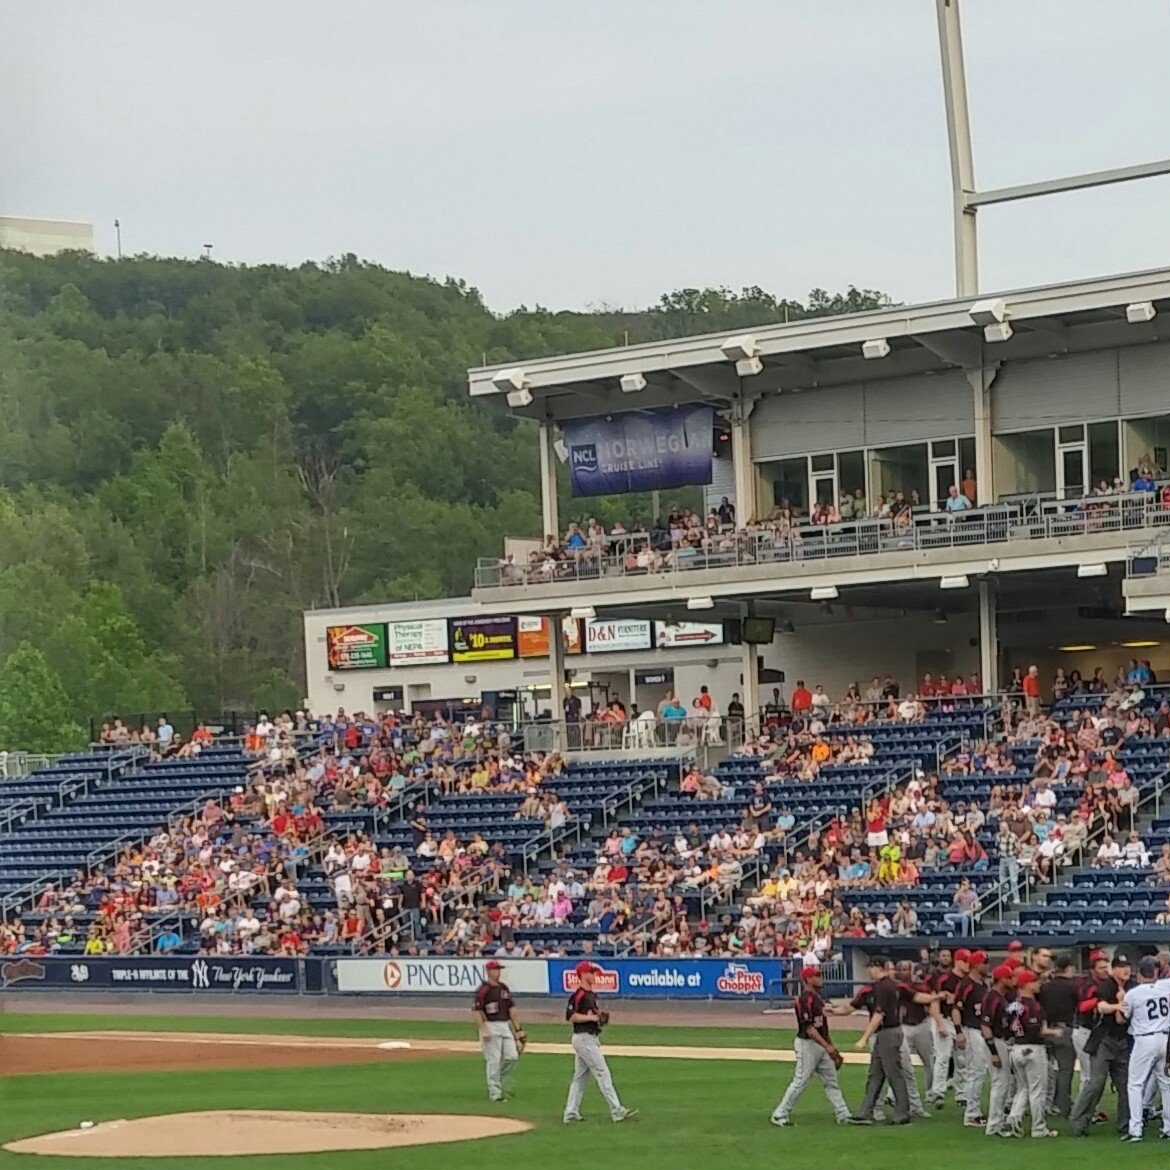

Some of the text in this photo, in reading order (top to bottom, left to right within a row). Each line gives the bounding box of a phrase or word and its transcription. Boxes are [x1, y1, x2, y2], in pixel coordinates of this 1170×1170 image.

[573, 450, 597, 464] NCL
[601, 460, 635, 473] CRUISE
[232, 966, 255, 989] York
[256, 966, 294, 989] Yankees
[405, 964, 486, 987] PNC BAN
[629, 968, 701, 987] available at
[738, 970, 762, 984] Price
[719, 978, 762, 993] Chopper
[1146, 996, 1169, 1020] 26
